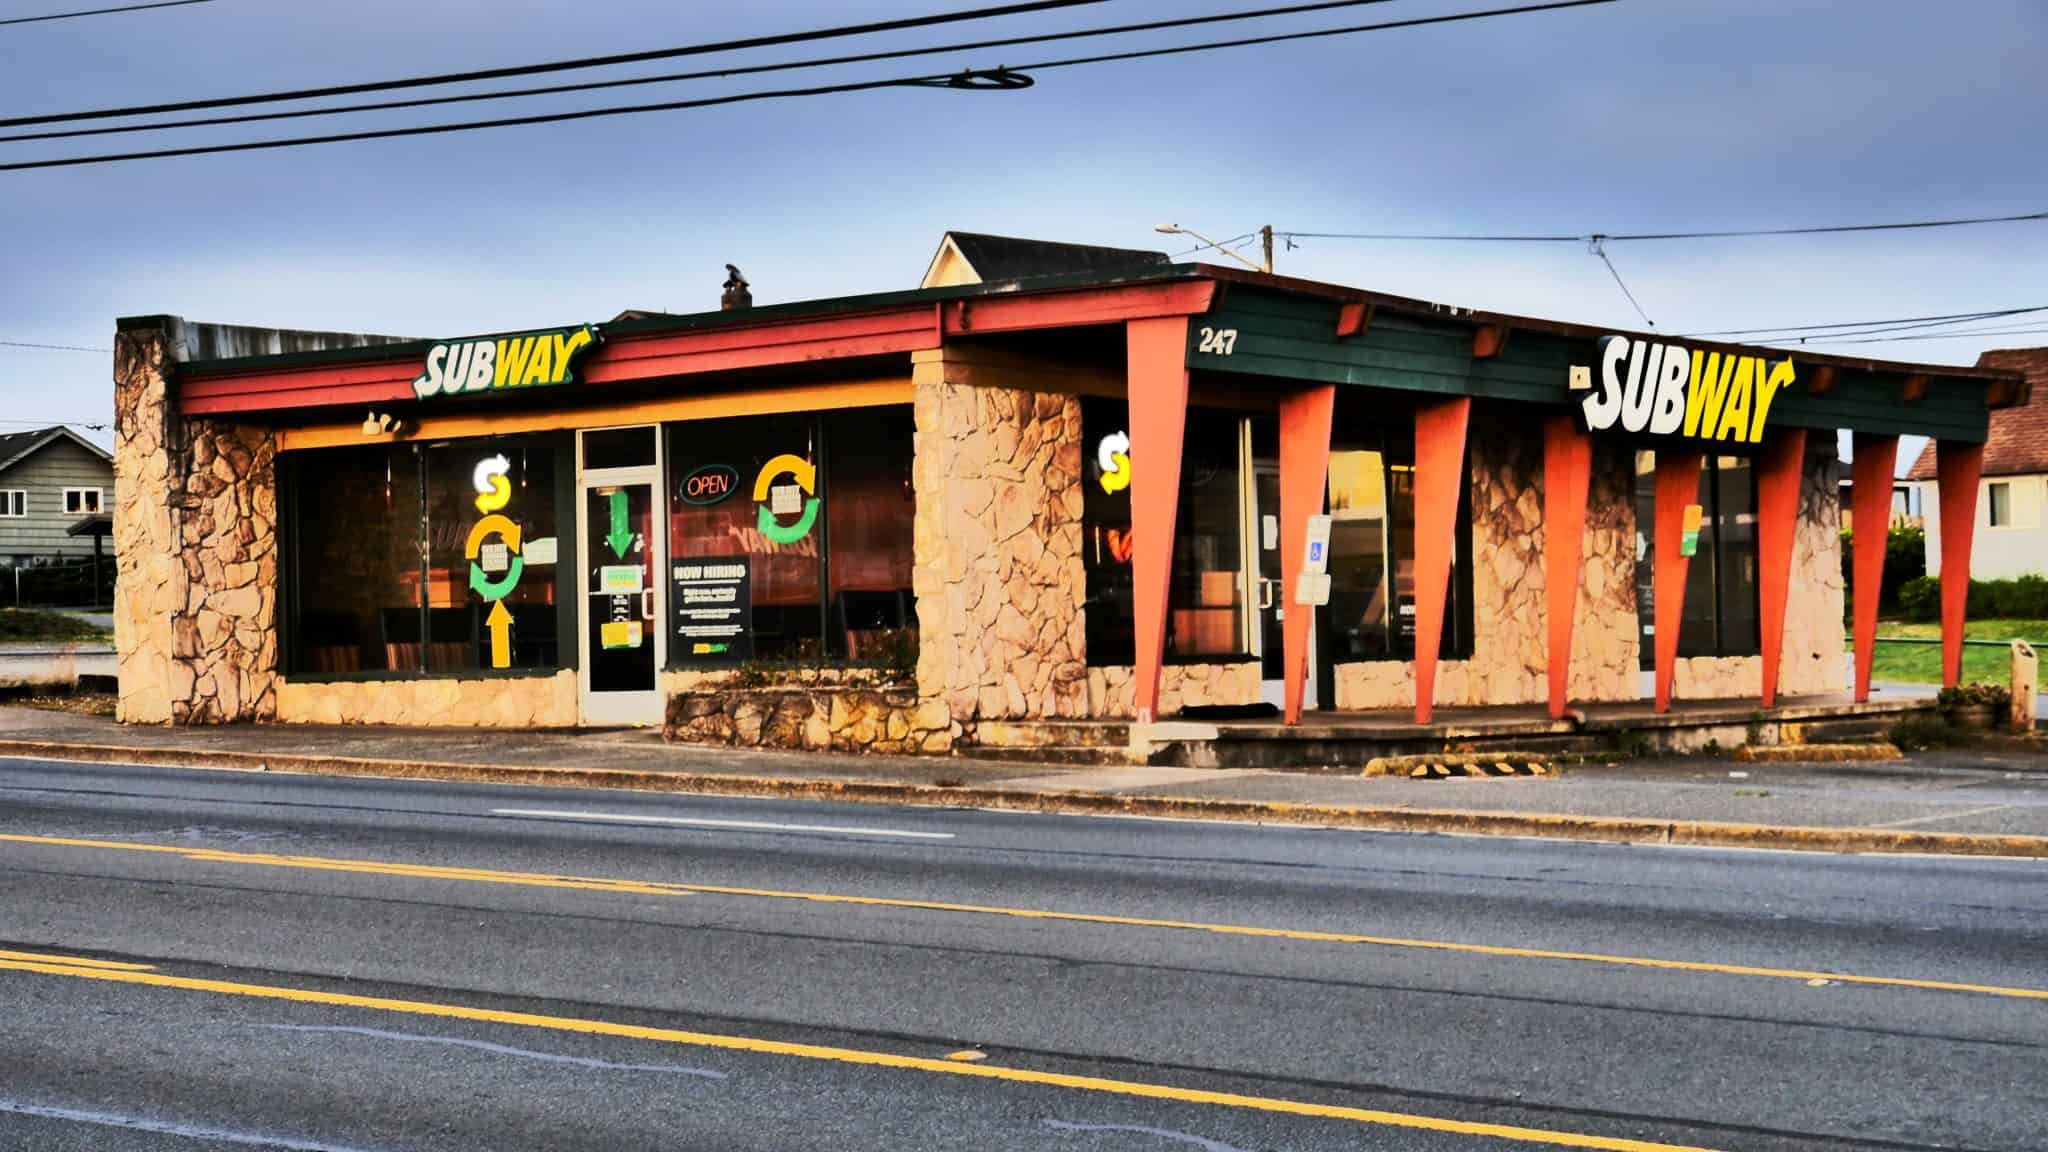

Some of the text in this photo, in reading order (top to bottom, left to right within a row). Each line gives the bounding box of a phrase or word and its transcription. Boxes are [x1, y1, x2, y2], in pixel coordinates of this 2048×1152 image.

[1199, 327, 1237, 355] 247
[413, 327, 592, 401] SUBWAY
[1582, 335, 1796, 443] SUBWAY
[687, 474, 729, 496] OPEN
[673, 566, 702, 580] NOW
